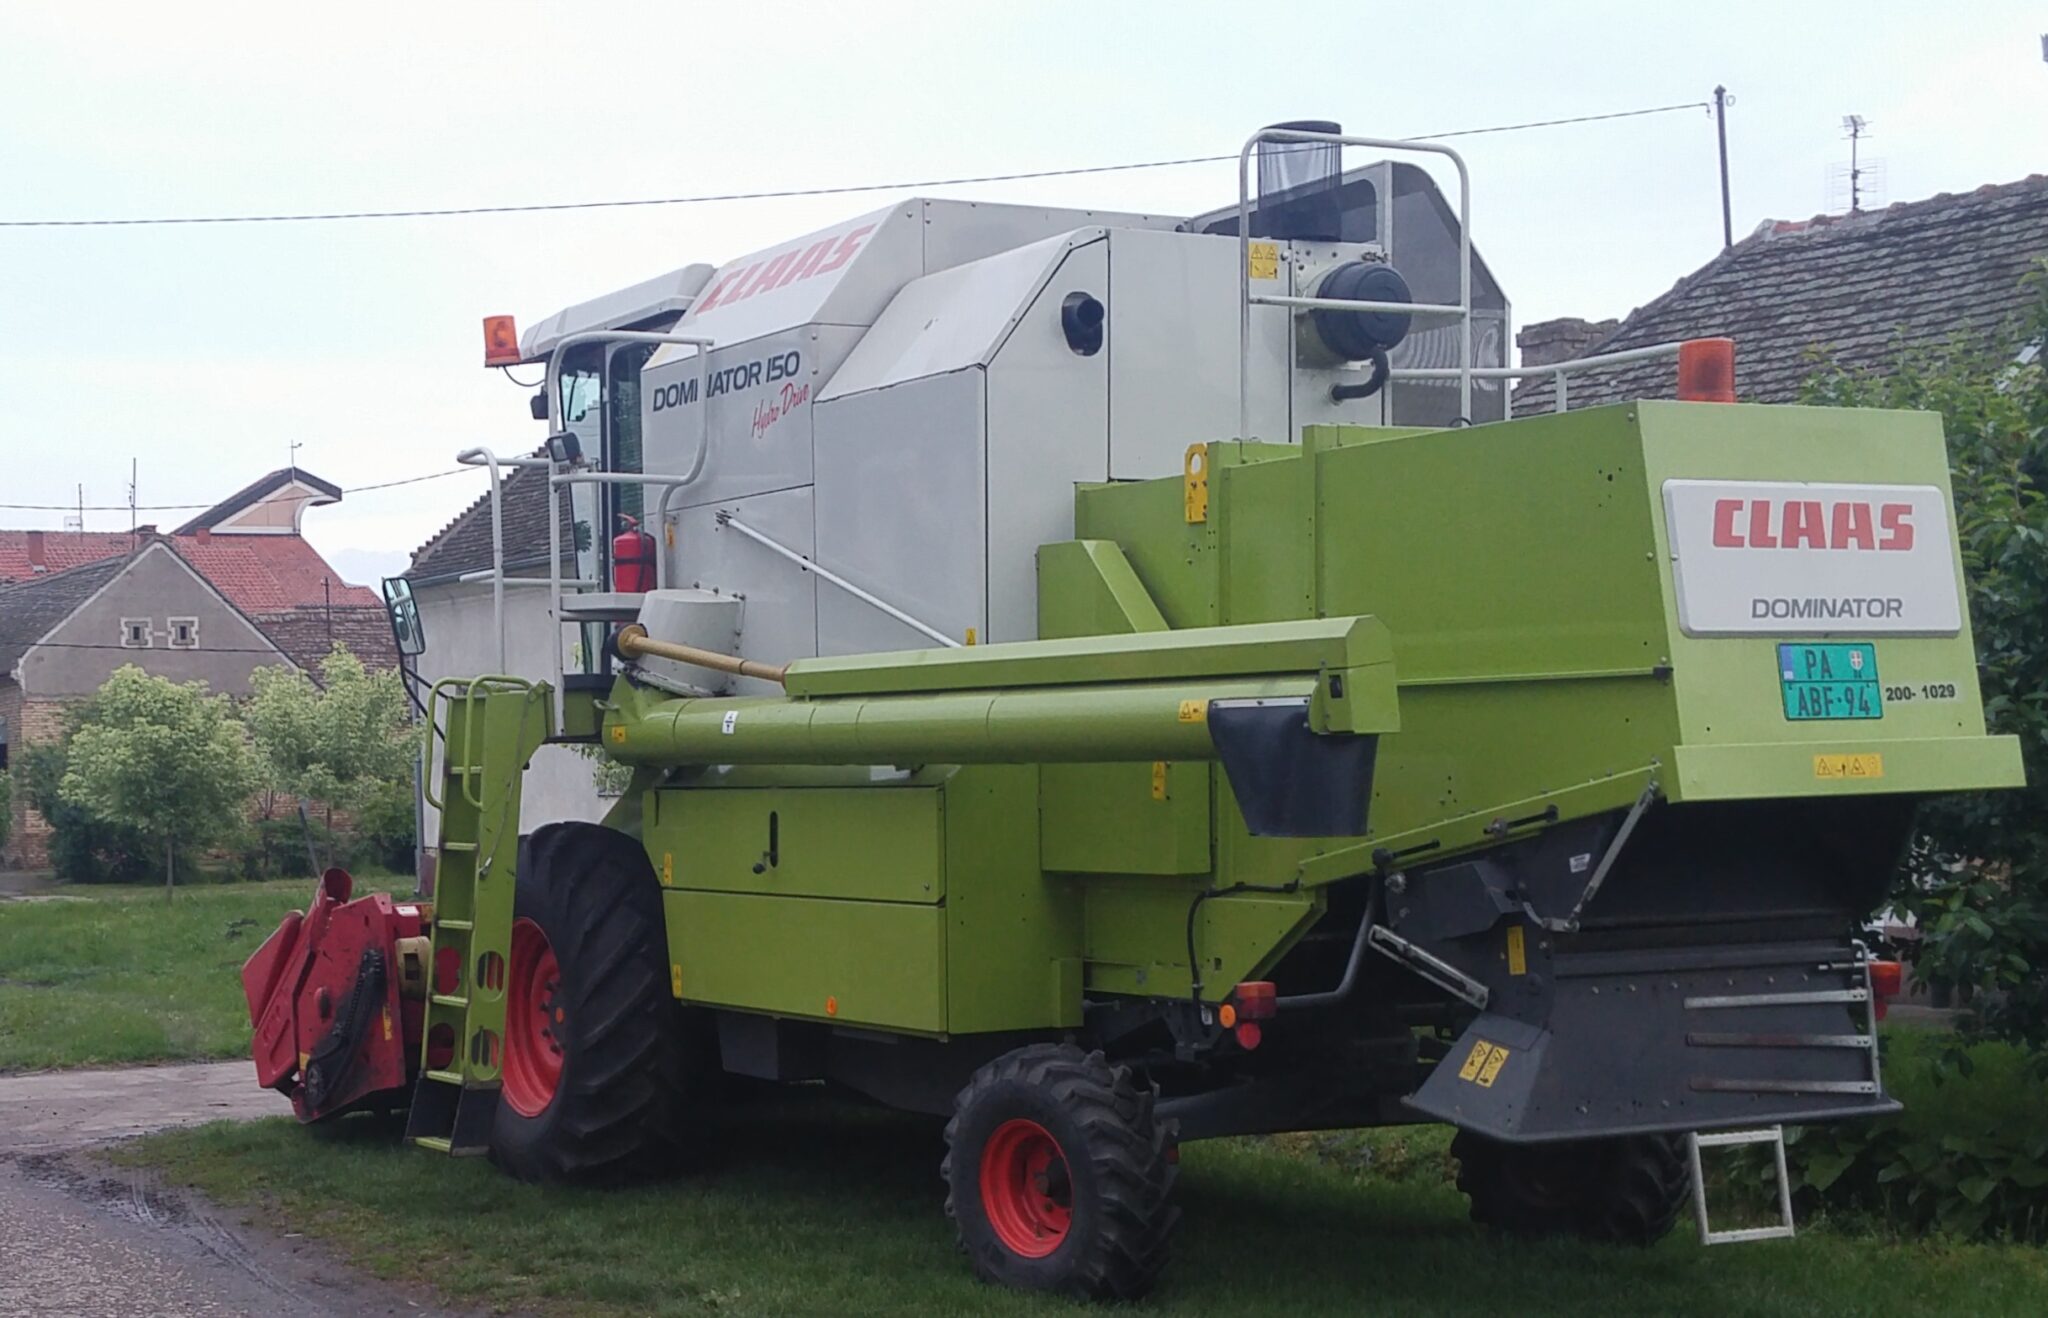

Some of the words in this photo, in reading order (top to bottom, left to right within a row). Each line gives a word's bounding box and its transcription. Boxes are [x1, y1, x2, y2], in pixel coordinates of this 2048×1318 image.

[695, 223, 877, 316] CLAAS
[766, 351, 801, 383] 150
[752, 399, 780, 439] Hydro
[780, 382, 809, 416] Drive
[1713, 499, 1914, 551] CLAAS
[1751, 598, 1903, 619] DOMINATOR
[1805, 649, 1833, 680] PA
[1885, 687, 1917, 702] 200-
[1921, 684, 1956, 700] 1029
